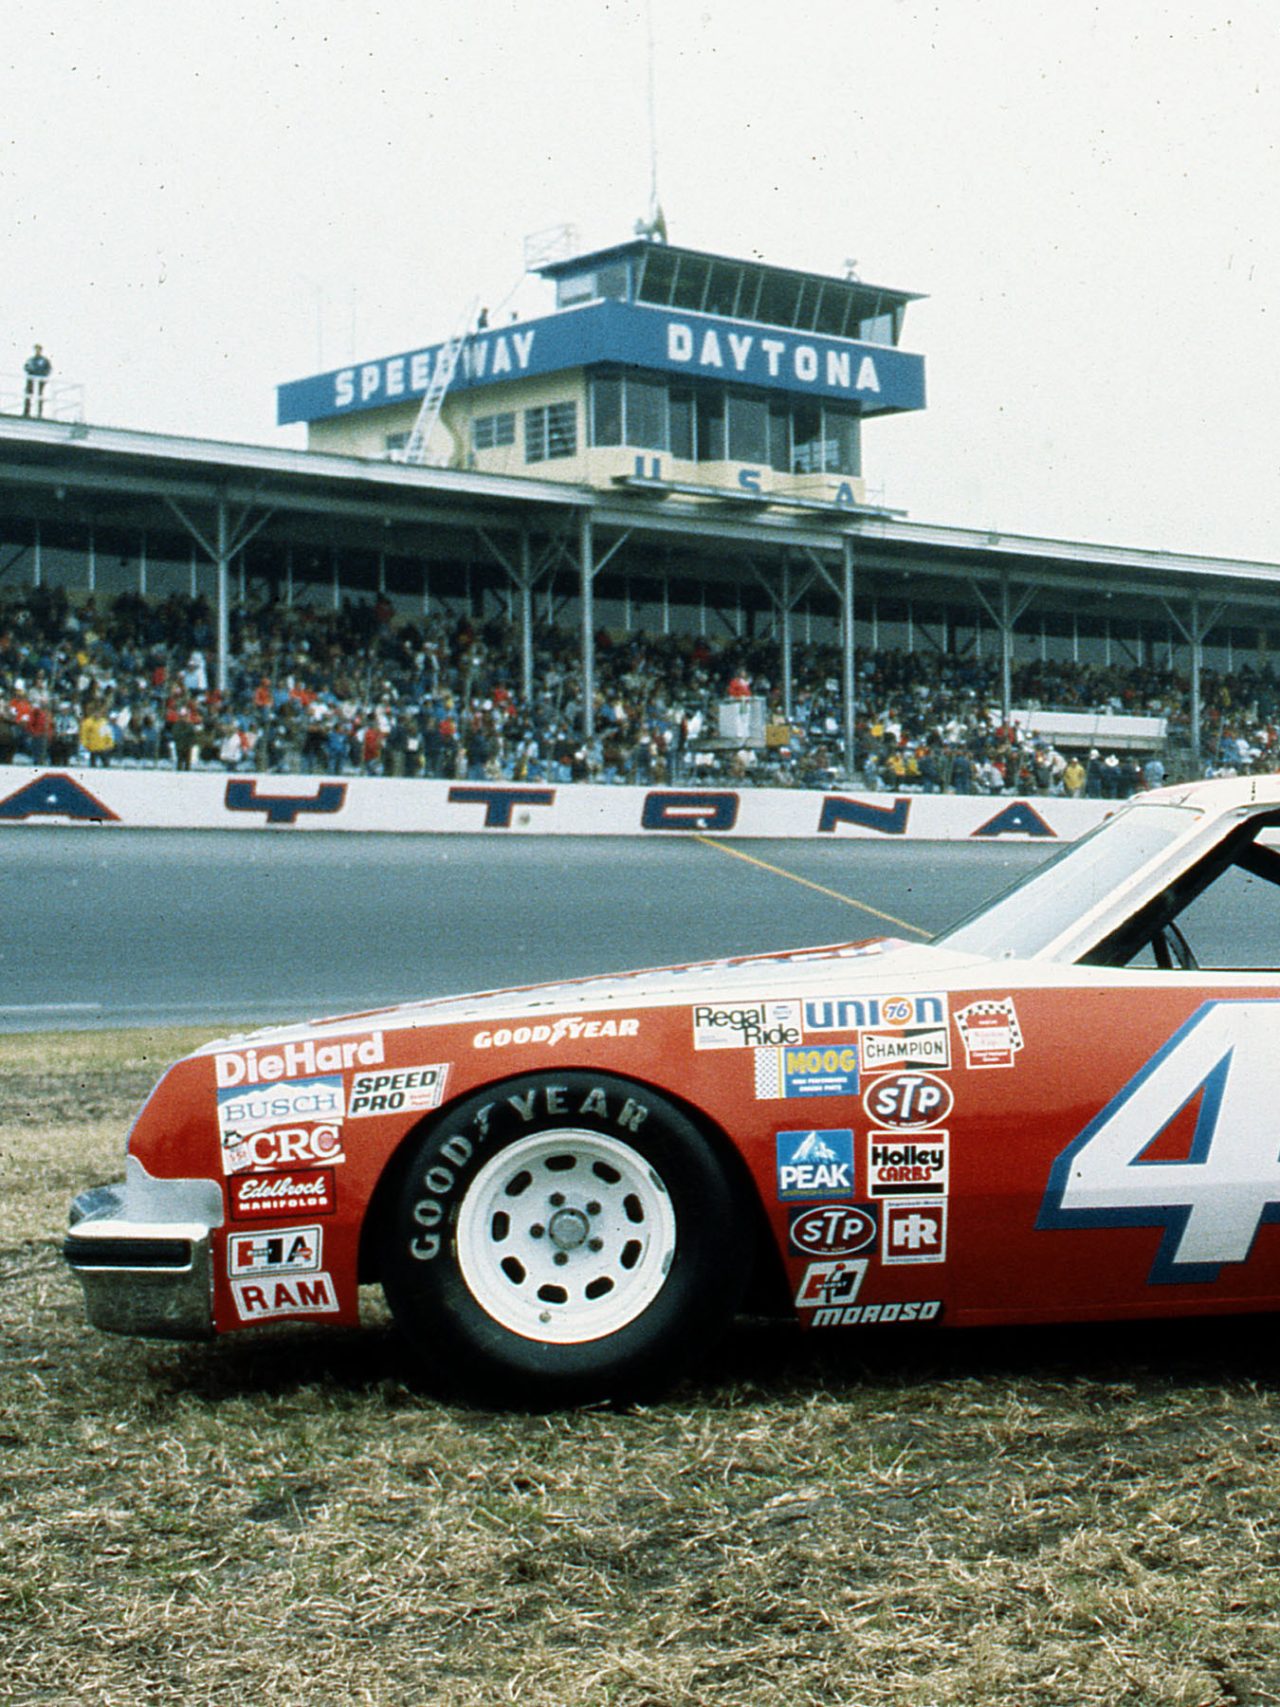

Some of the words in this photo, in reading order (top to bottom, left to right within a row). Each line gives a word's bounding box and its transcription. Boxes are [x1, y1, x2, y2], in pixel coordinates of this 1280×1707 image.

[667, 322, 881, 393] DAYTONA
[695, 1004, 767, 1031] Regal
[744, 1024, 800, 1046] Ride
[215, 1031, 385, 1088] DieHard
[787, 1049, 857, 1075] MOOG
[866, 1041, 944, 1058] CHAMPION
[355, 1071, 437, 1095] SPEED
[225, 1093, 336, 1122] BUSCH
[352, 1092, 405, 1112] PRO
[876, 1077, 941, 1119] STP
[249, 1125, 342, 1165] CRC
[872, 1145, 944, 1171] Holley
[780, 1163, 850, 1190] PEAK
[878, 1166, 933, 1182] CARBS
[238, 1176, 327, 1200] Edelbrock
[802, 1211, 864, 1245] STP
[240, 1280, 331, 1312] RAM
[811, 1301, 942, 1327] MOROSO
